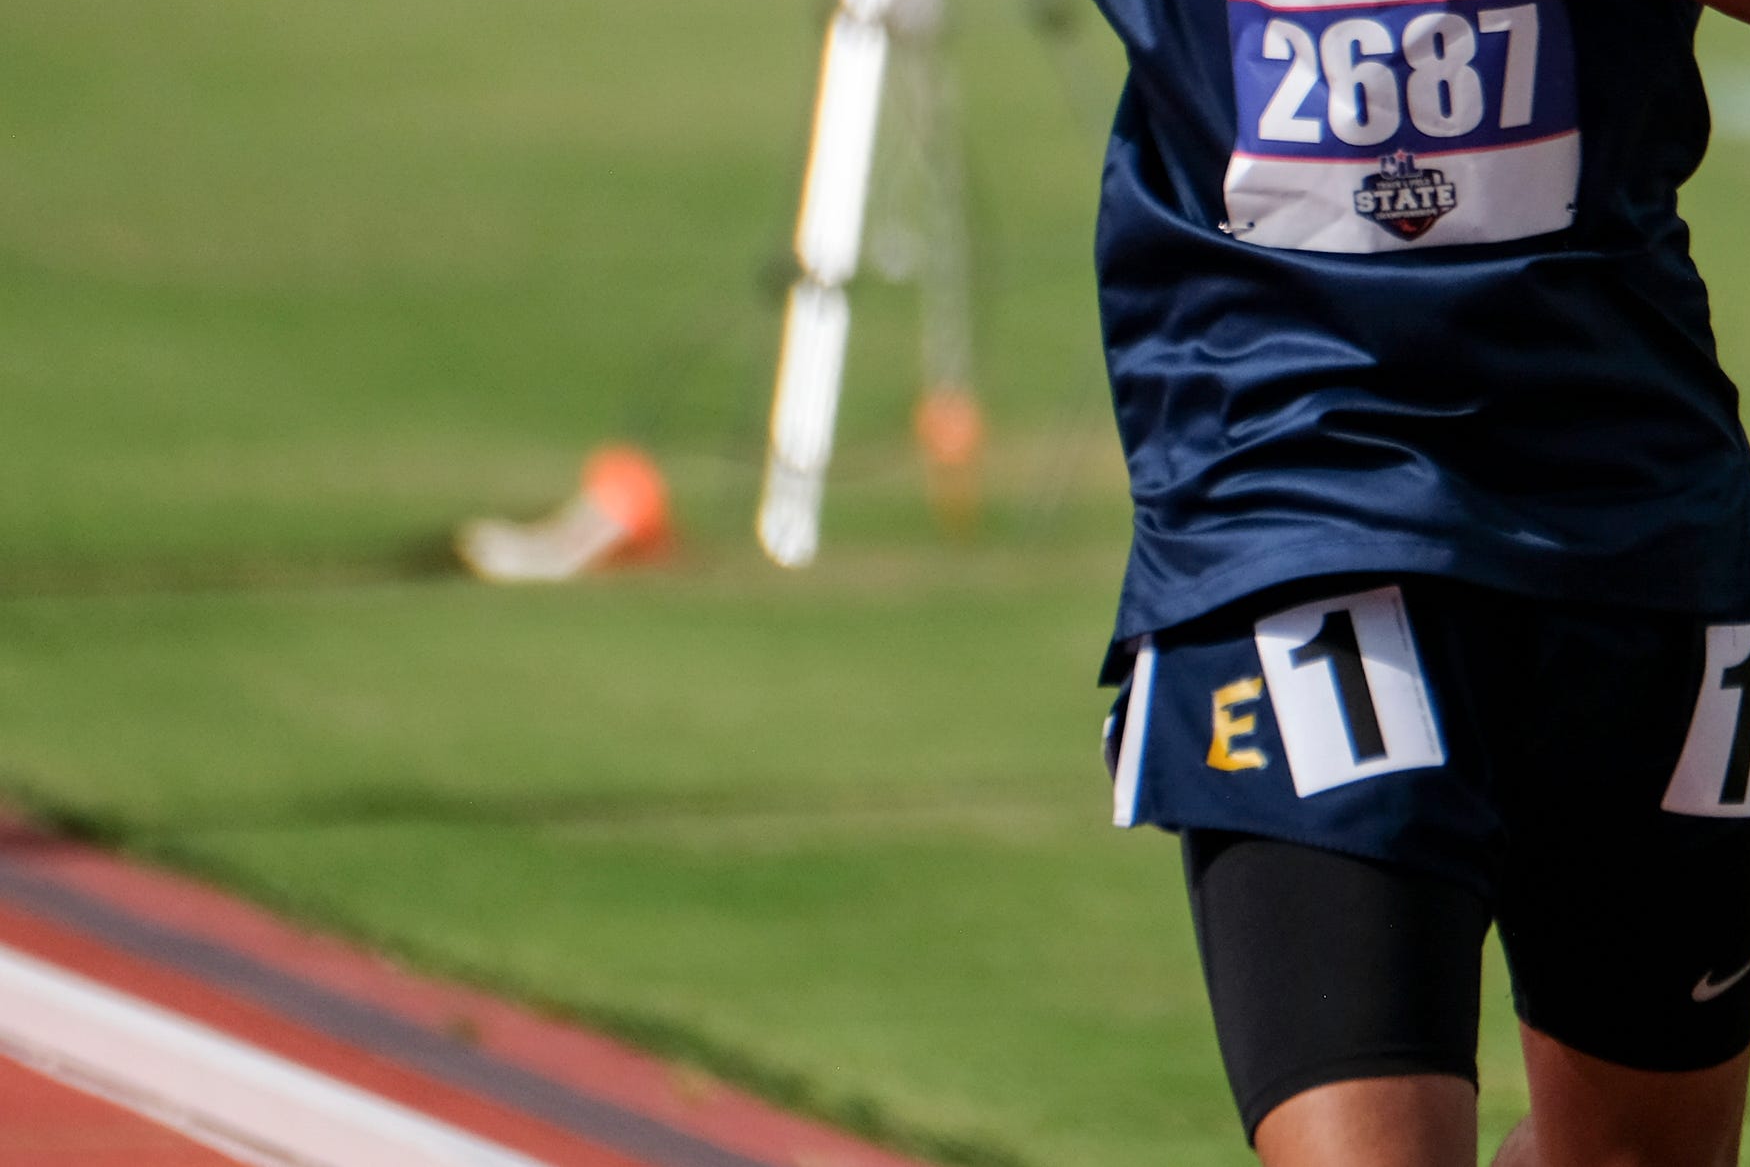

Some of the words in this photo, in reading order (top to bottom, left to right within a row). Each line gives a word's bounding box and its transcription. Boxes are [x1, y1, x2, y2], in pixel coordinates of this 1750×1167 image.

[1259, 3, 1539, 147] 2687
[1355, 184, 1455, 213] STATE
[1207, 677, 1266, 770] E
[1290, 609, 1388, 766] 1
